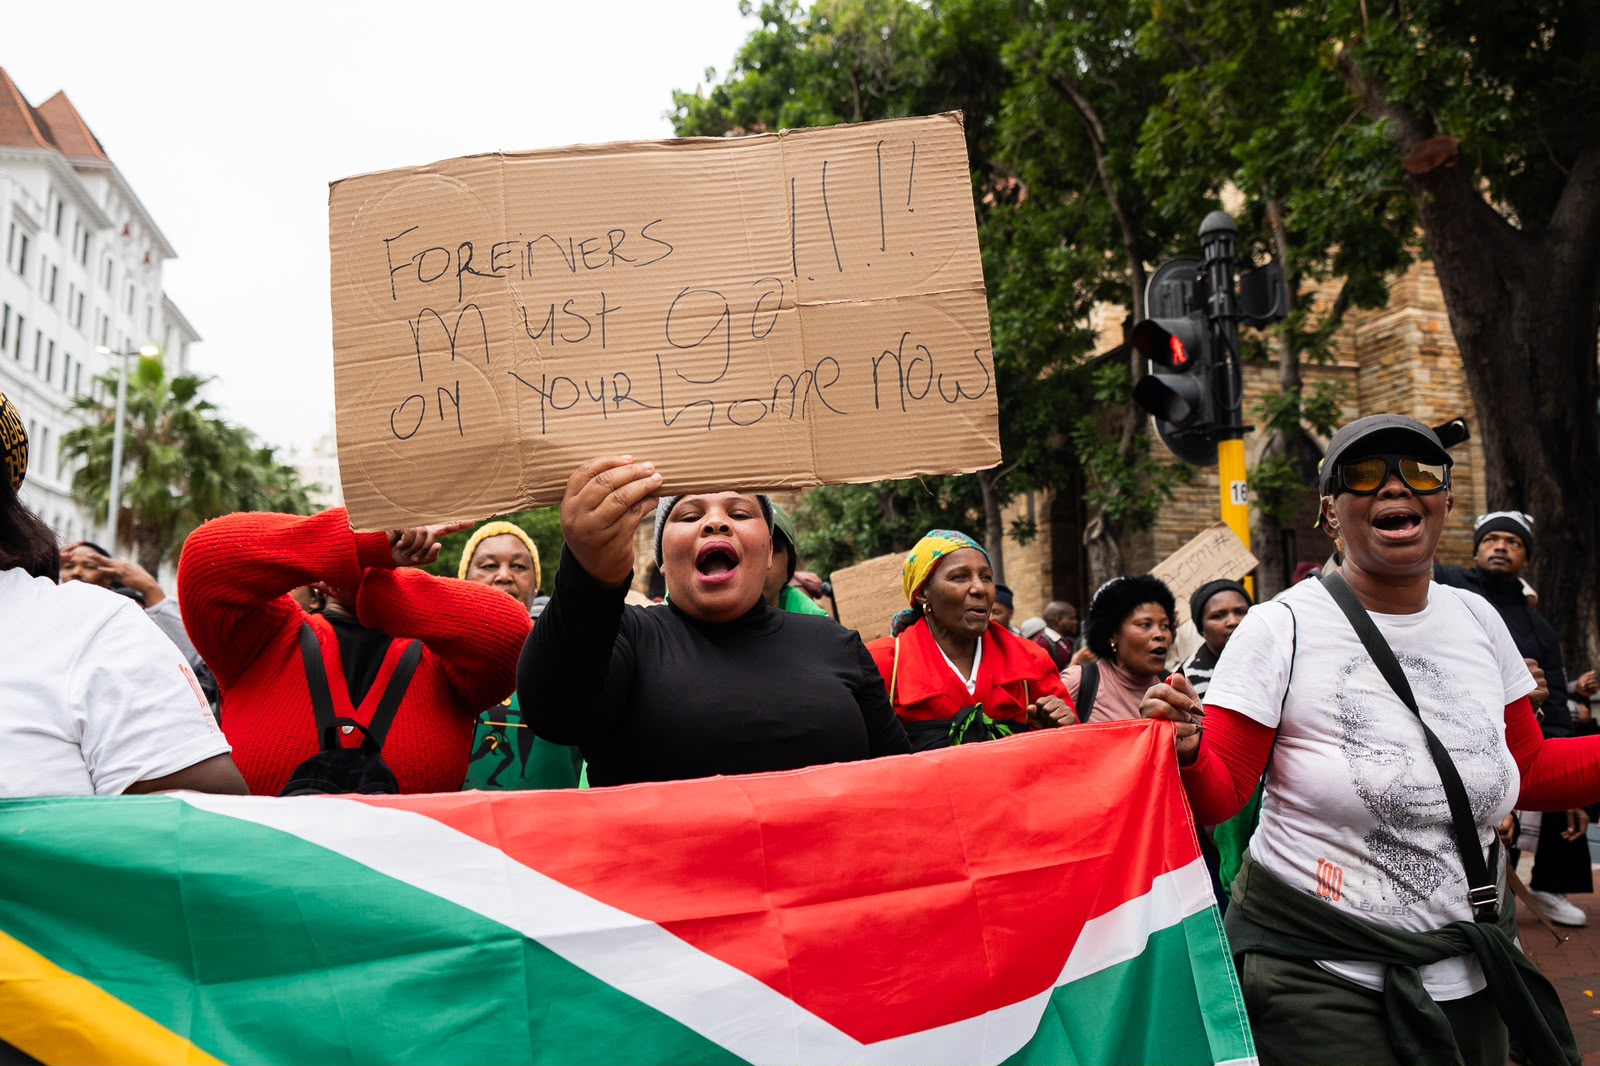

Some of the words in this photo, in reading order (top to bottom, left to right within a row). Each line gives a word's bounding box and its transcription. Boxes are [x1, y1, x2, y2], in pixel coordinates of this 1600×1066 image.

[390, 379, 464, 440] ON
[506, 371, 664, 435] YOUR
[1333, 712, 1364, 721] LOVE
